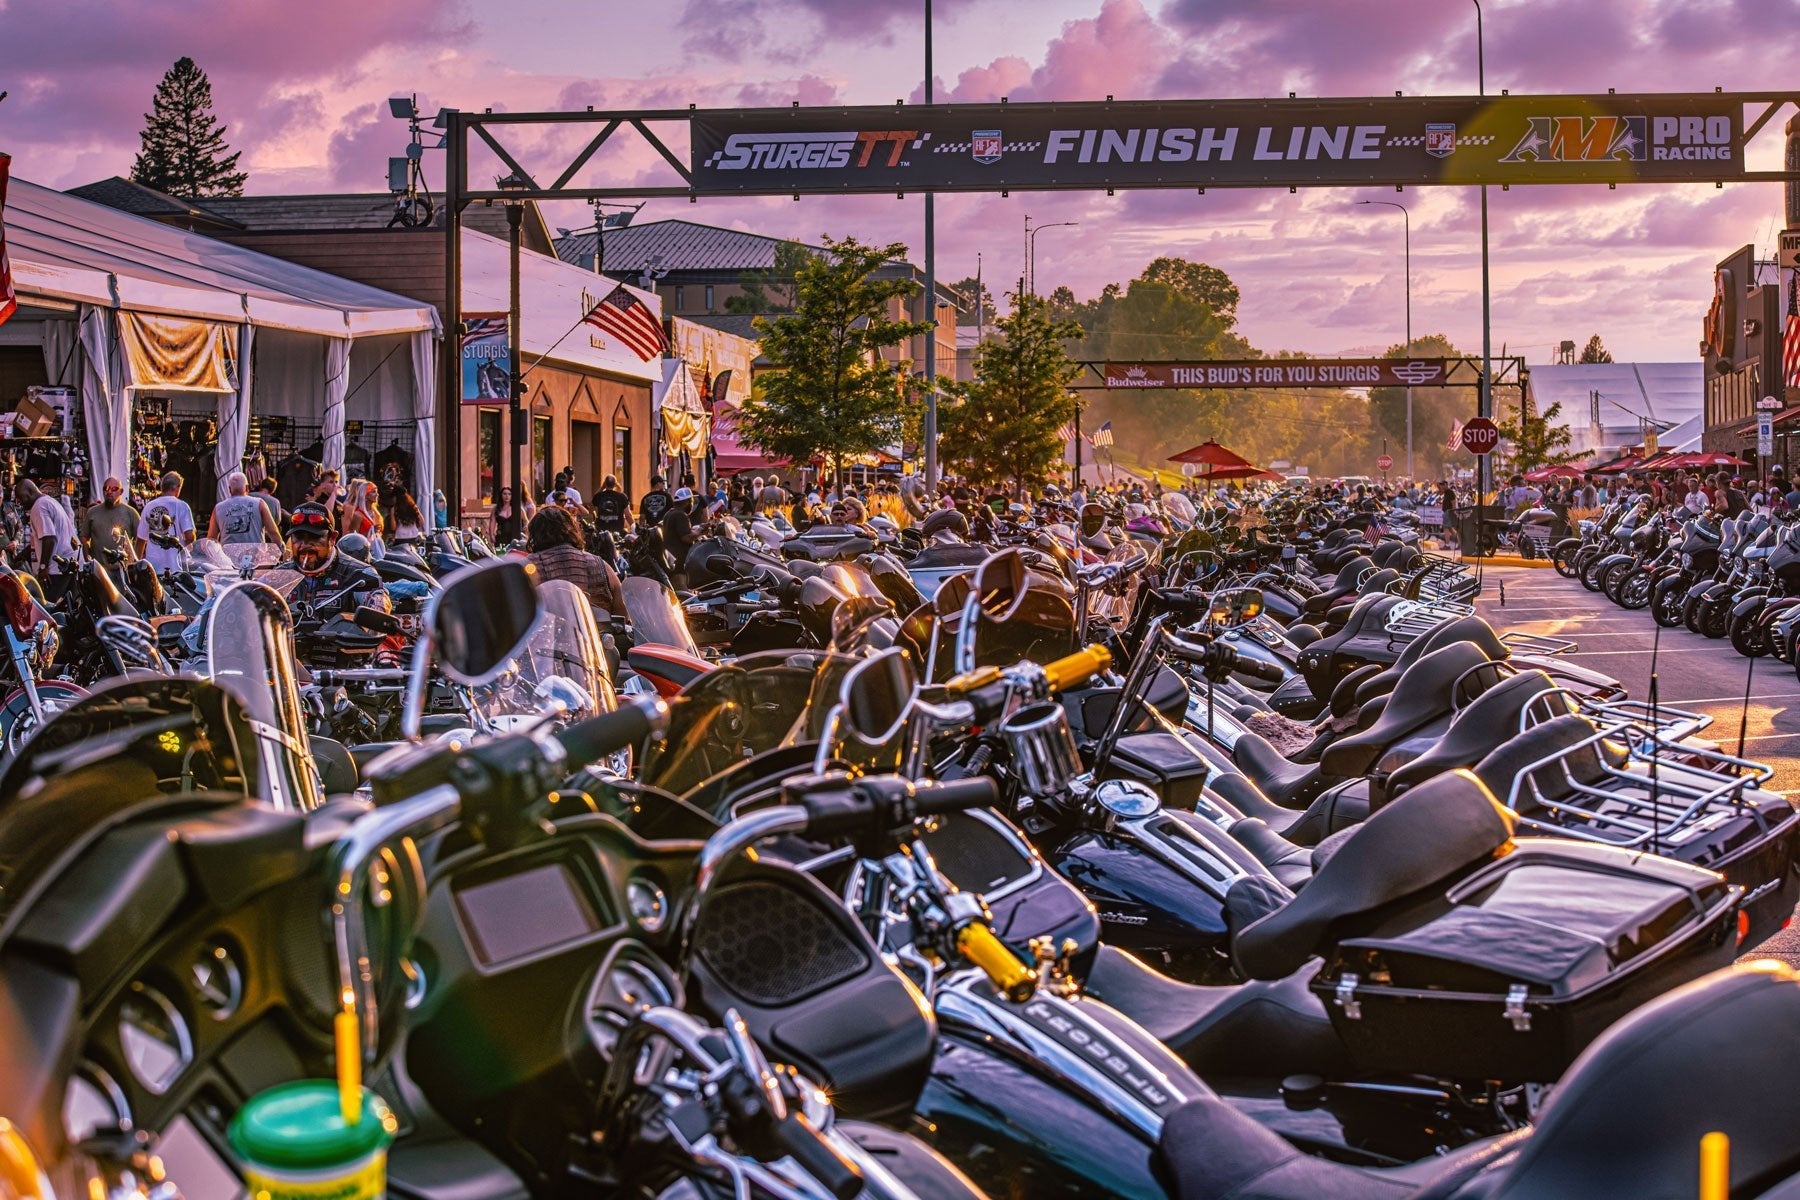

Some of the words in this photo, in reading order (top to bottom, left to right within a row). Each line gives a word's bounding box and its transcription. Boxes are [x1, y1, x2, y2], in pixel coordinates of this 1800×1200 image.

[1498, 116, 1647, 162] AMA
[1653, 116, 1731, 145] PRO
[717, 131, 858, 170] STURGIS
[857, 130, 918, 168] TT
[1044, 127, 1238, 164] FINISH
[1253, 125, 1386, 161] LINE
[1653, 146, 1731, 160] RACING
[464, 345, 508, 359] STURGIS
[1107, 376, 1165, 387] Budweiser
[1171, 368, 1204, 384] THIS
[1208, 367, 1251, 383] BUD'S
[1255, 367, 1283, 383] FOR
[1286, 366, 1315, 382] YOU
[1318, 365, 1380, 382] STURGIS
[1464, 428, 1496, 443] STOP
[1377, 459, 1392, 467] STOP
